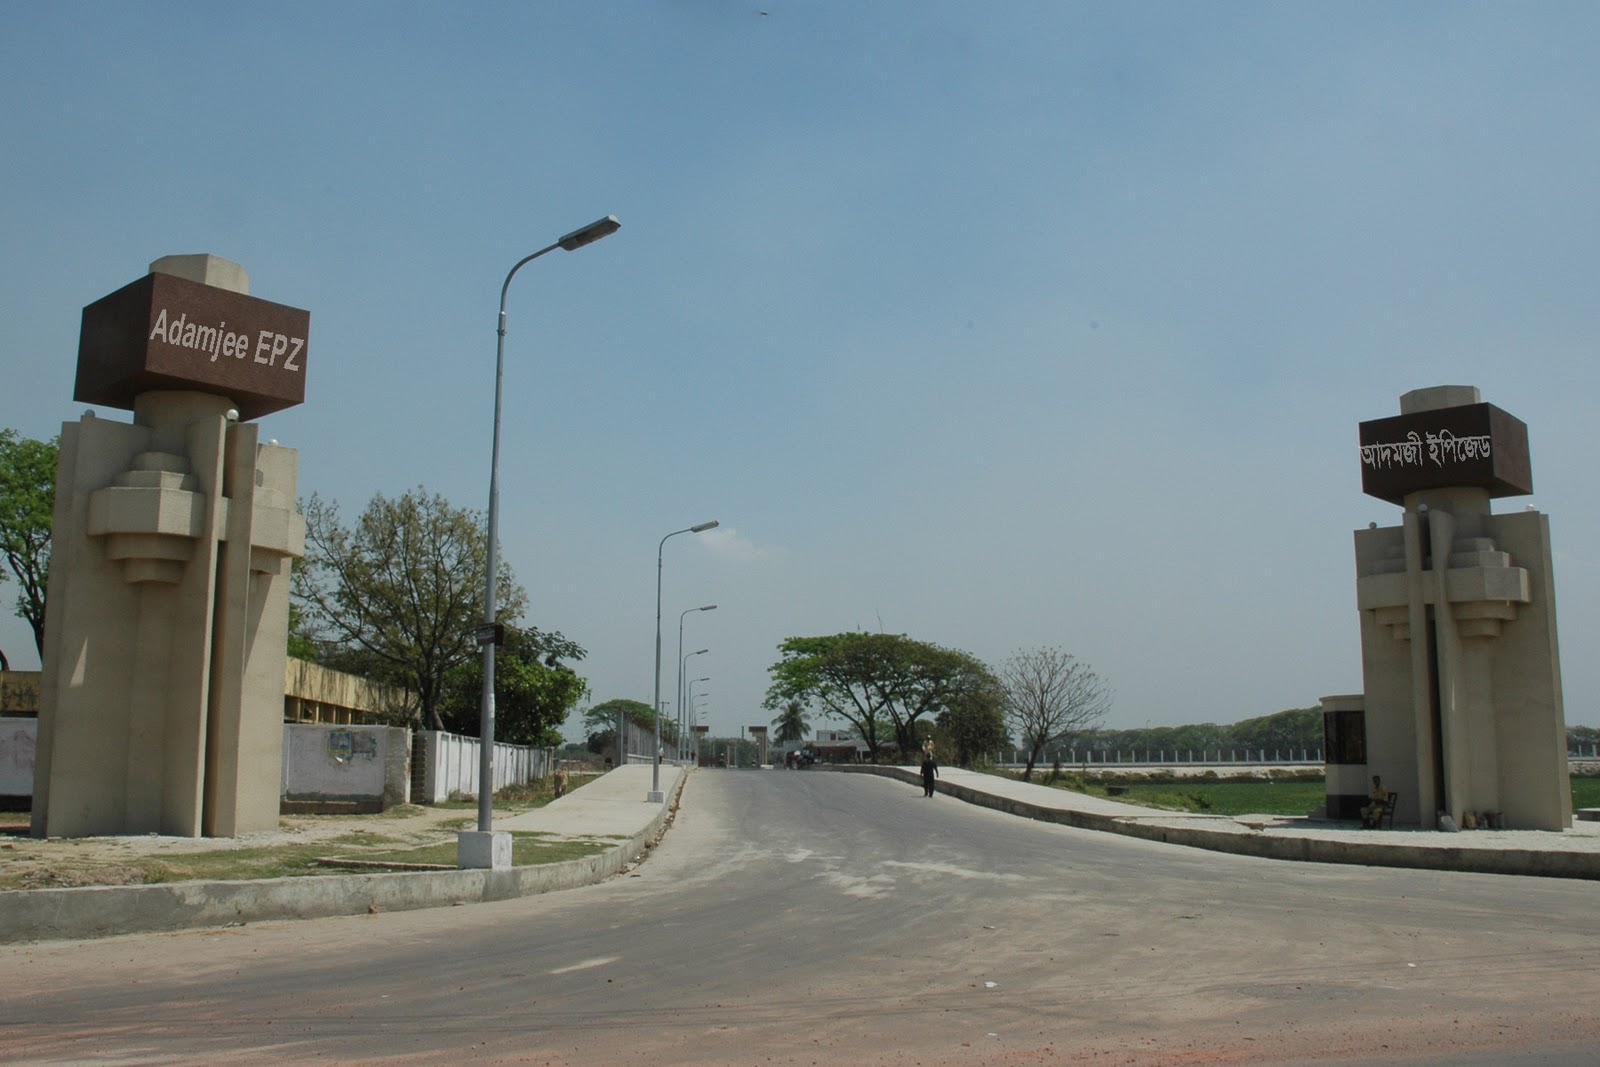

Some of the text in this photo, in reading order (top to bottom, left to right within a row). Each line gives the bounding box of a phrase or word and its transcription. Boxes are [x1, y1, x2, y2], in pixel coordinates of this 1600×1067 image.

[150, 308, 304, 372] Adamjee EPZ
[1359, 428, 1491, 470] আদমজী ইপিজেড
